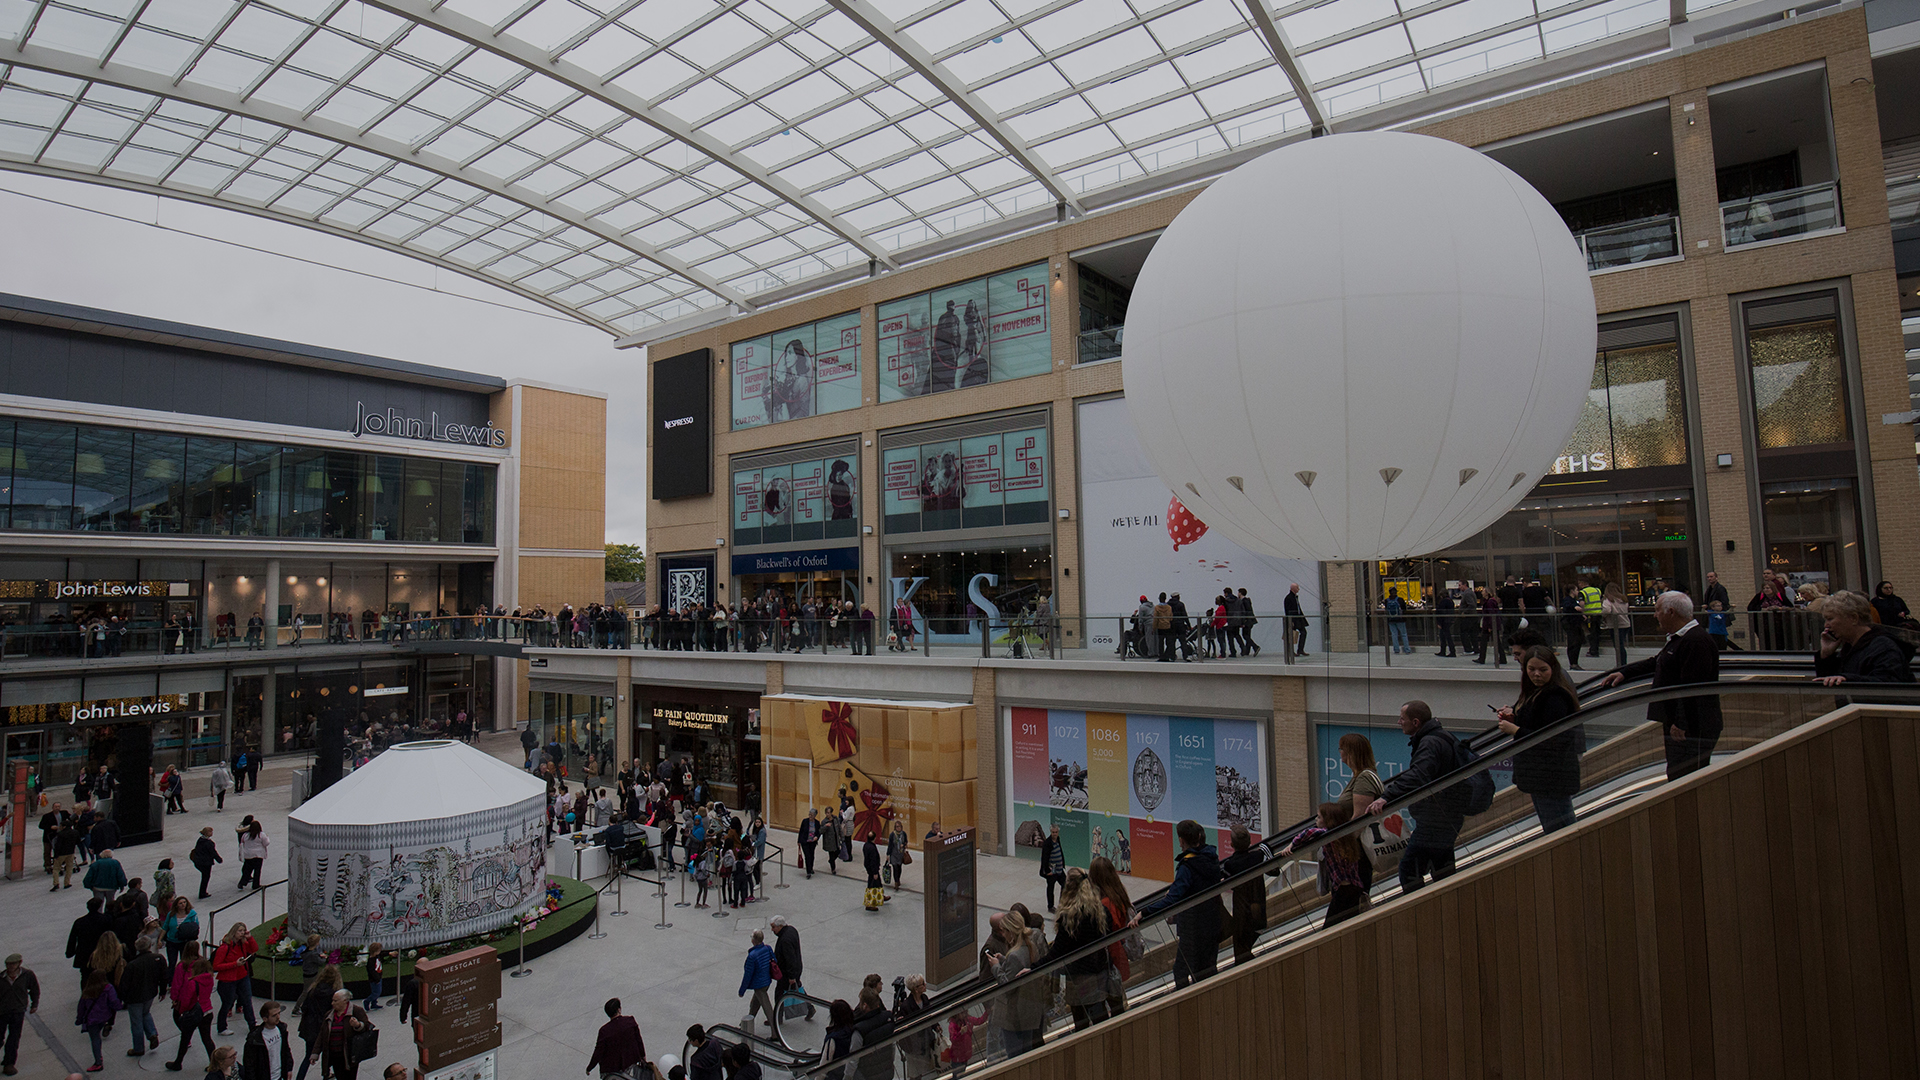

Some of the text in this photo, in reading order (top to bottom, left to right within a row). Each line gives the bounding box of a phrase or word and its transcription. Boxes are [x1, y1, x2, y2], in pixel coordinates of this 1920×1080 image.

[883, 321, 903, 333] OPENS
[992, 315, 1041, 334] 17 NOVEMBER
[819, 363, 852, 377] EXPERIENCE
[744, 383, 761, 394] FINEST
[351, 401, 506, 447] John Lewis
[664, 416, 694, 430] NESPRESSO
[735, 414, 761, 426] CURZON
[756, 555, 828, 569] Blackwell's of Oxford
[55, 581, 150, 600] John Lewis
[68, 699, 171, 725] John Lewis
[653, 708, 728, 723] LE PAIN QUOTIDIEN
[668, 718, 683, 729] Bakery
[688, 721, 713, 730] Restaurant
[1021, 723, 1036, 735] 911
[1054, 726, 1080, 739] 1072
[1092, 728, 1120, 742] 1086
[1135, 731, 1160, 745] 1167
[1178, 734, 1205, 748] 1651
[1222, 737, 1253, 752] 1774
[885, 779, 912, 788] GODIVA
[944, 832, 967, 845] WESTGATE
[1369, 822, 1386, 844] I
[443, 958, 480, 974] WESTGATE
